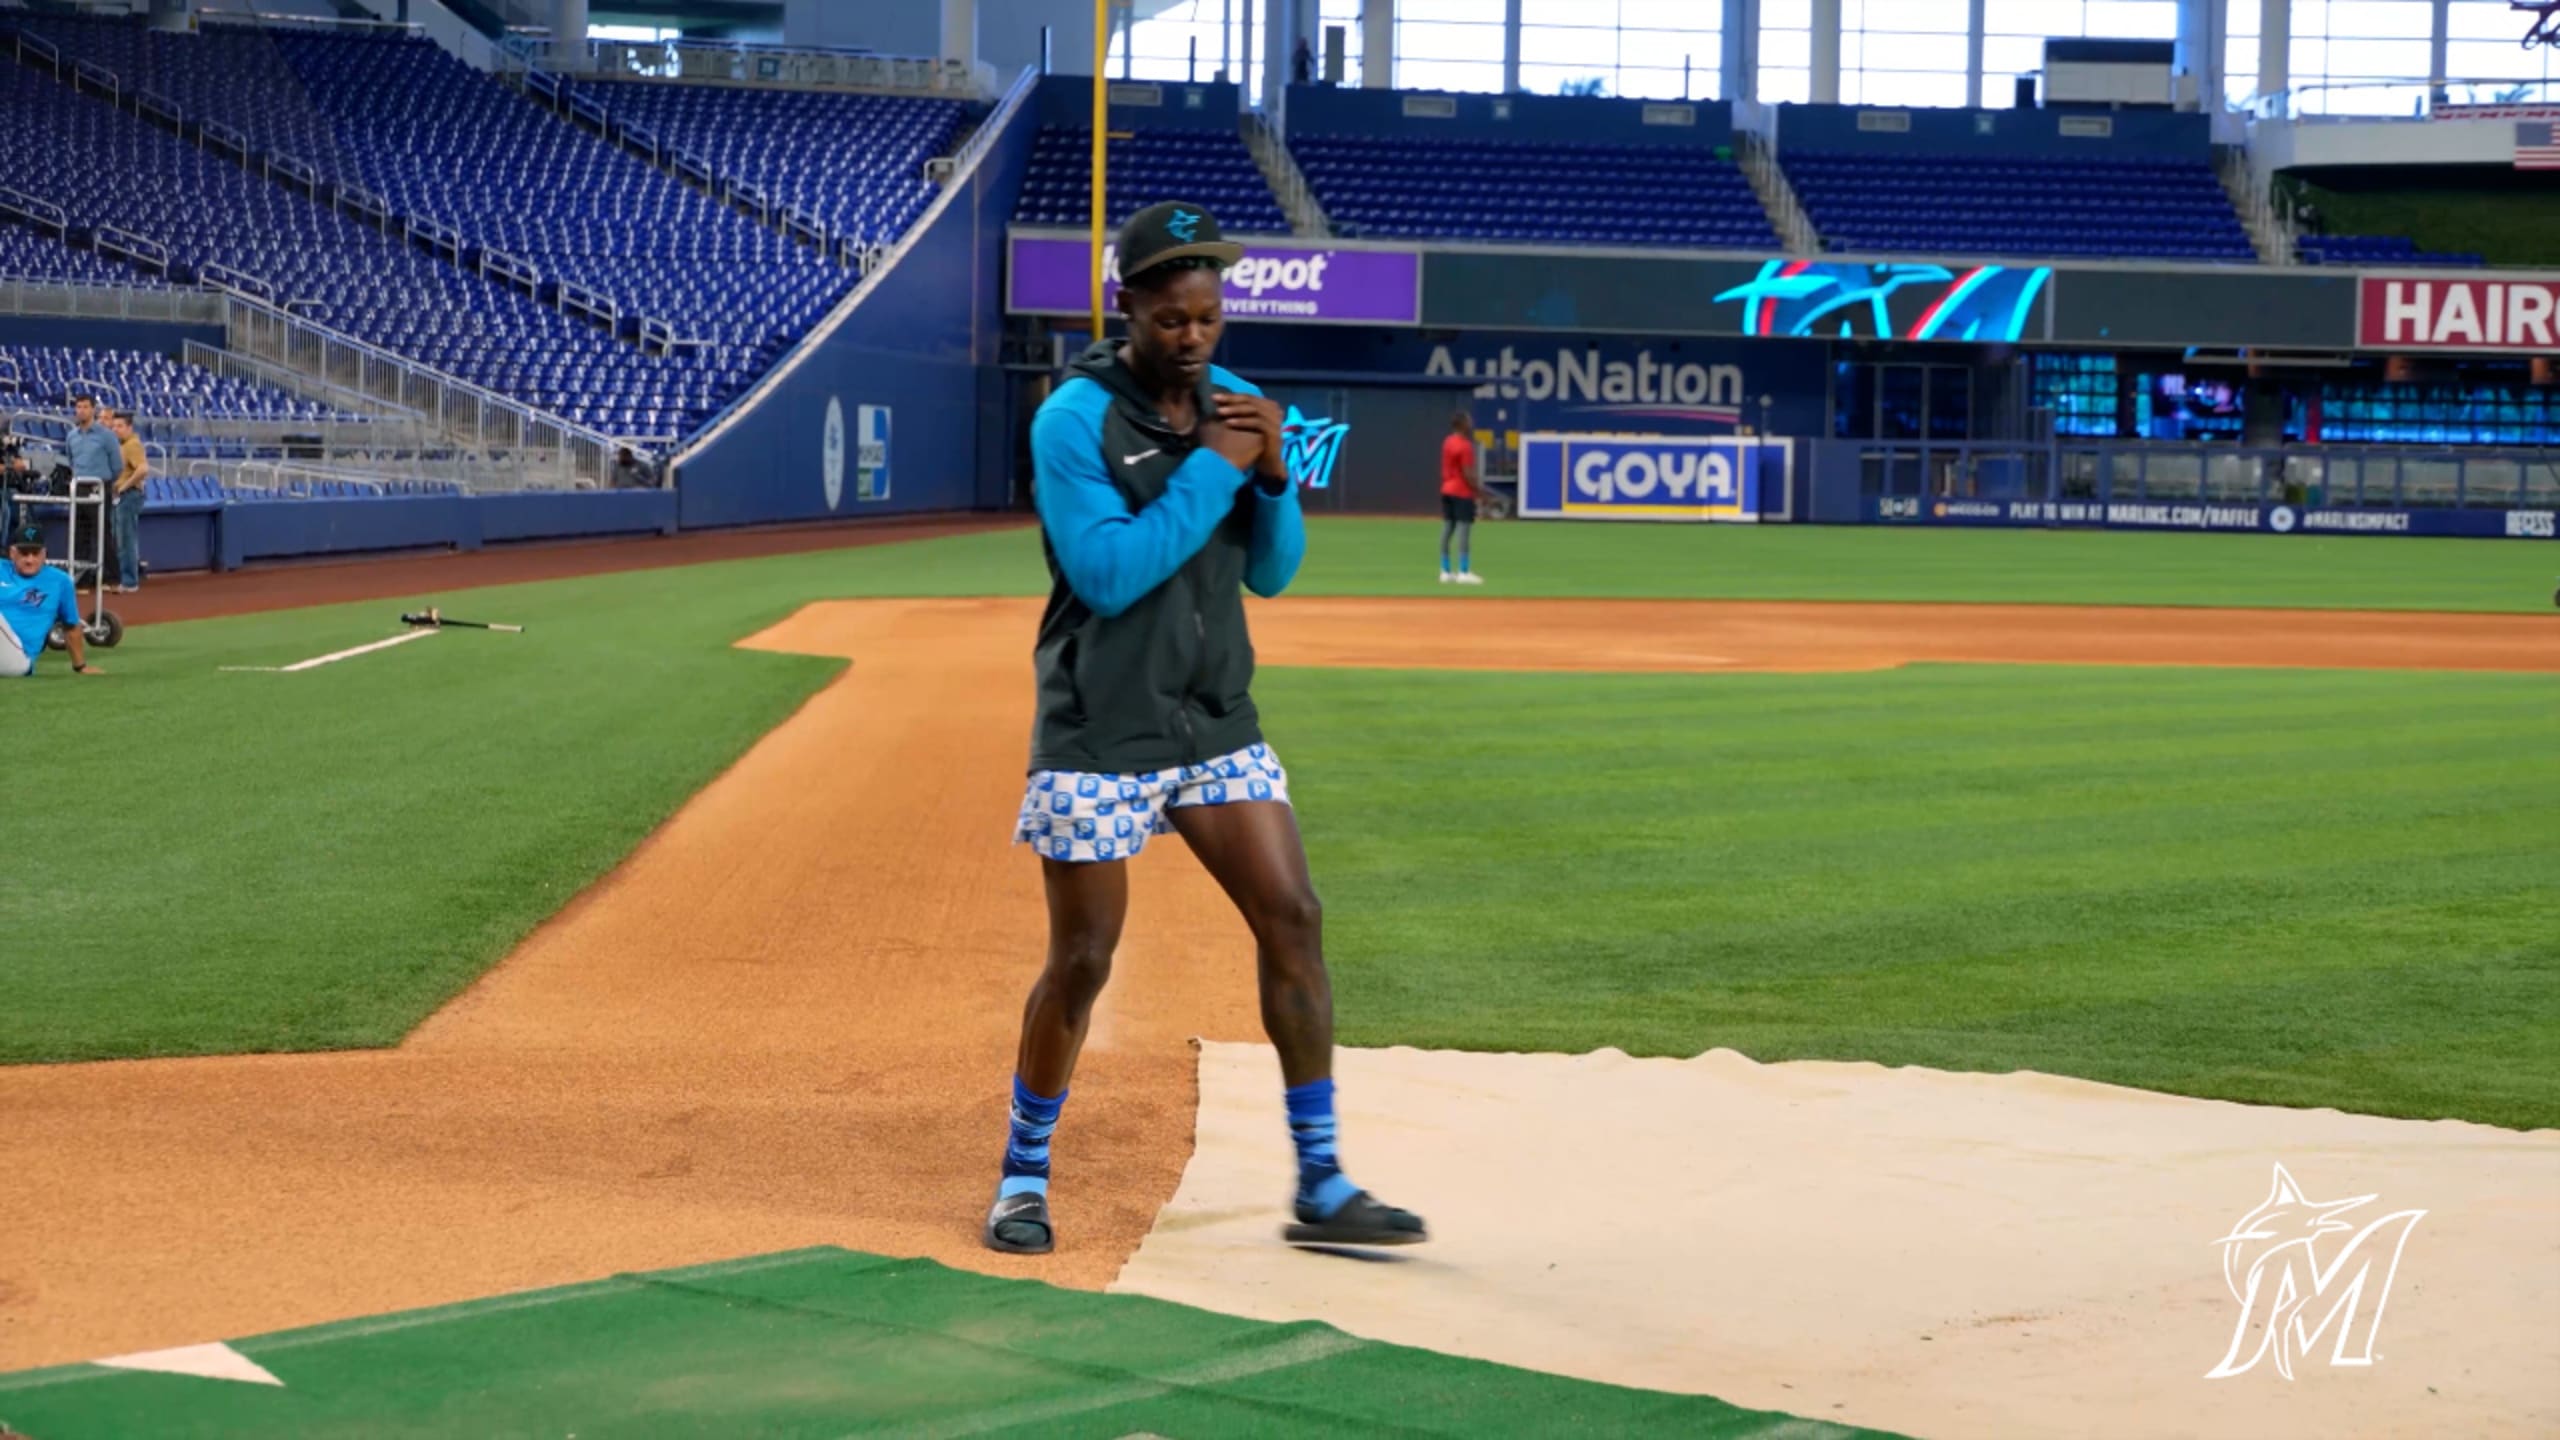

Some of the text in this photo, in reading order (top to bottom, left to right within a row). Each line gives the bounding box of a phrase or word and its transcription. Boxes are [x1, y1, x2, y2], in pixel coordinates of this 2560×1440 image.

[1221, 250, 1325, 296] epot
[1222, 298, 1318, 316] EVERYTHING
[2383, 282, 2560, 345] HAIR
[1425, 345, 1743, 405] AutoNation
[1573, 450, 1731, 502] GOYA
[2010, 501, 2040, 520] PLAY
[2043, 502, 2057, 520] TO
[2060, 503, 2085, 521] WIN
[2088, 503, 2103, 521] AT
